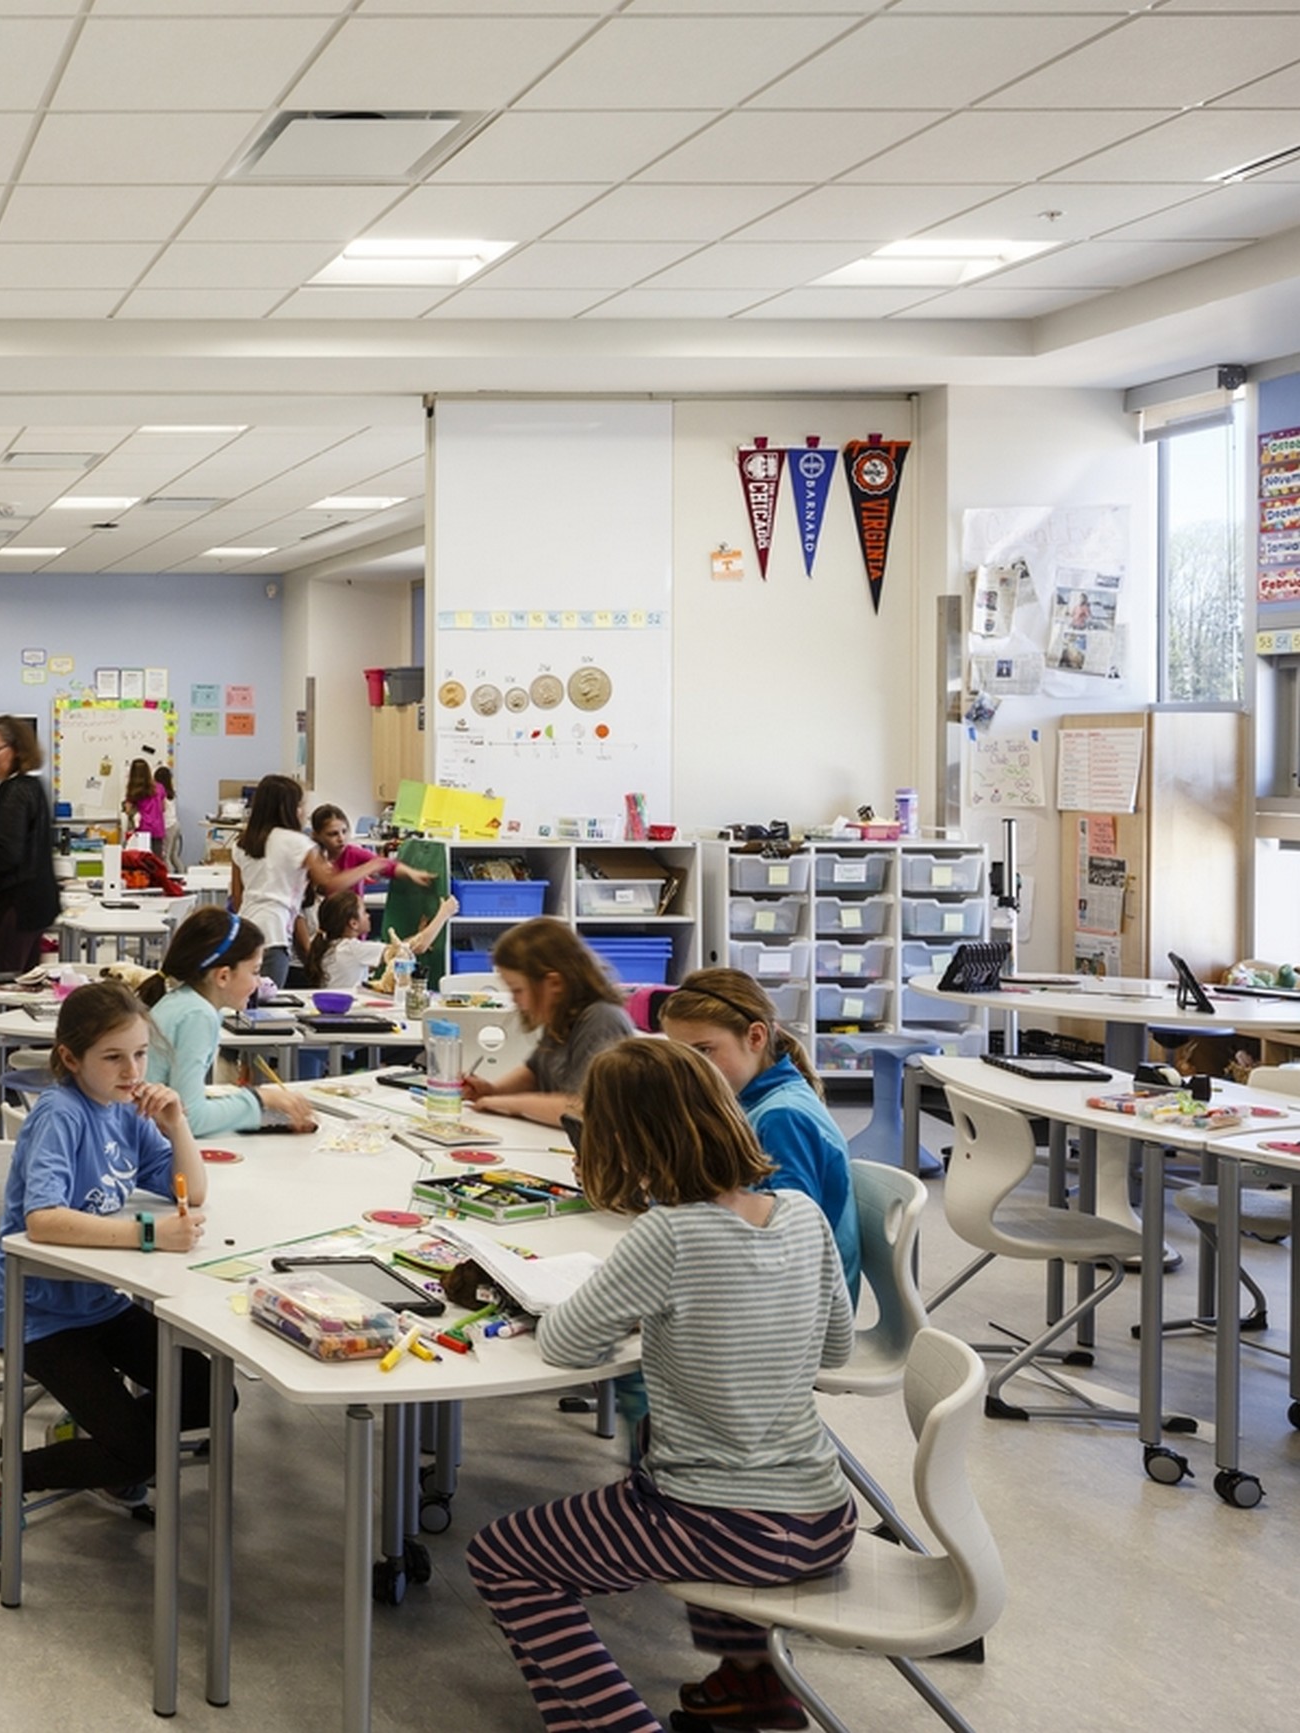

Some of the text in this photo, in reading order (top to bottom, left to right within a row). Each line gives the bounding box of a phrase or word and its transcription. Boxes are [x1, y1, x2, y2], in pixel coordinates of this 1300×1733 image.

[749, 482, 770, 549] CHICAGO
[805, 480, 816, 552] BARNARD
[860, 498, 890, 581] VIRGINIA
[722, 560, 733, 571] T
